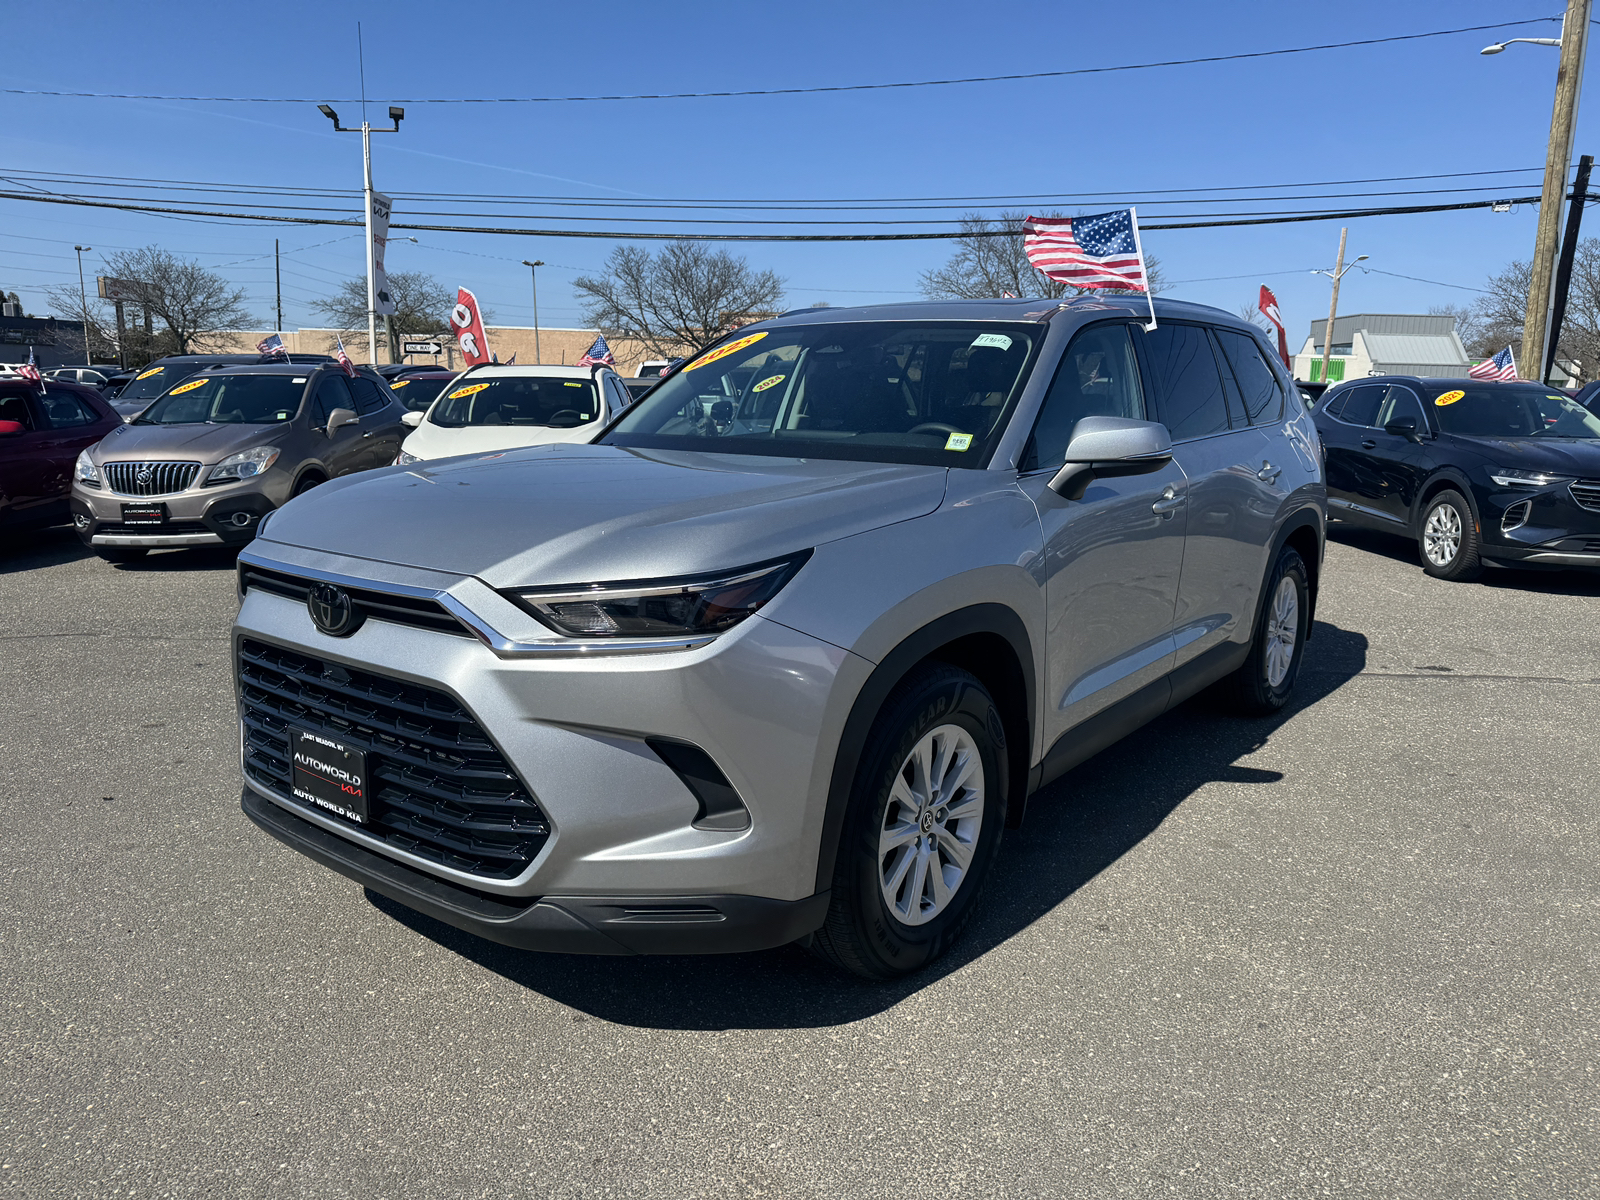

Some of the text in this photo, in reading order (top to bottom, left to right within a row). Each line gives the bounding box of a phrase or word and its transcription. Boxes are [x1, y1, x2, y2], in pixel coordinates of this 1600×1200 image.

[373, 205, 389, 220] KIA
[756, 375, 782, 390] 2024
[454, 384, 484, 398] 2021
[1438, 391, 1461, 405] 2021
[871, 696, 946, 825] GOODYEAR
[294, 752, 361, 786] AUTOWORLD
[341, 783, 362, 797] KIA
[294, 788, 362, 823] AUTO WORLD KIA
